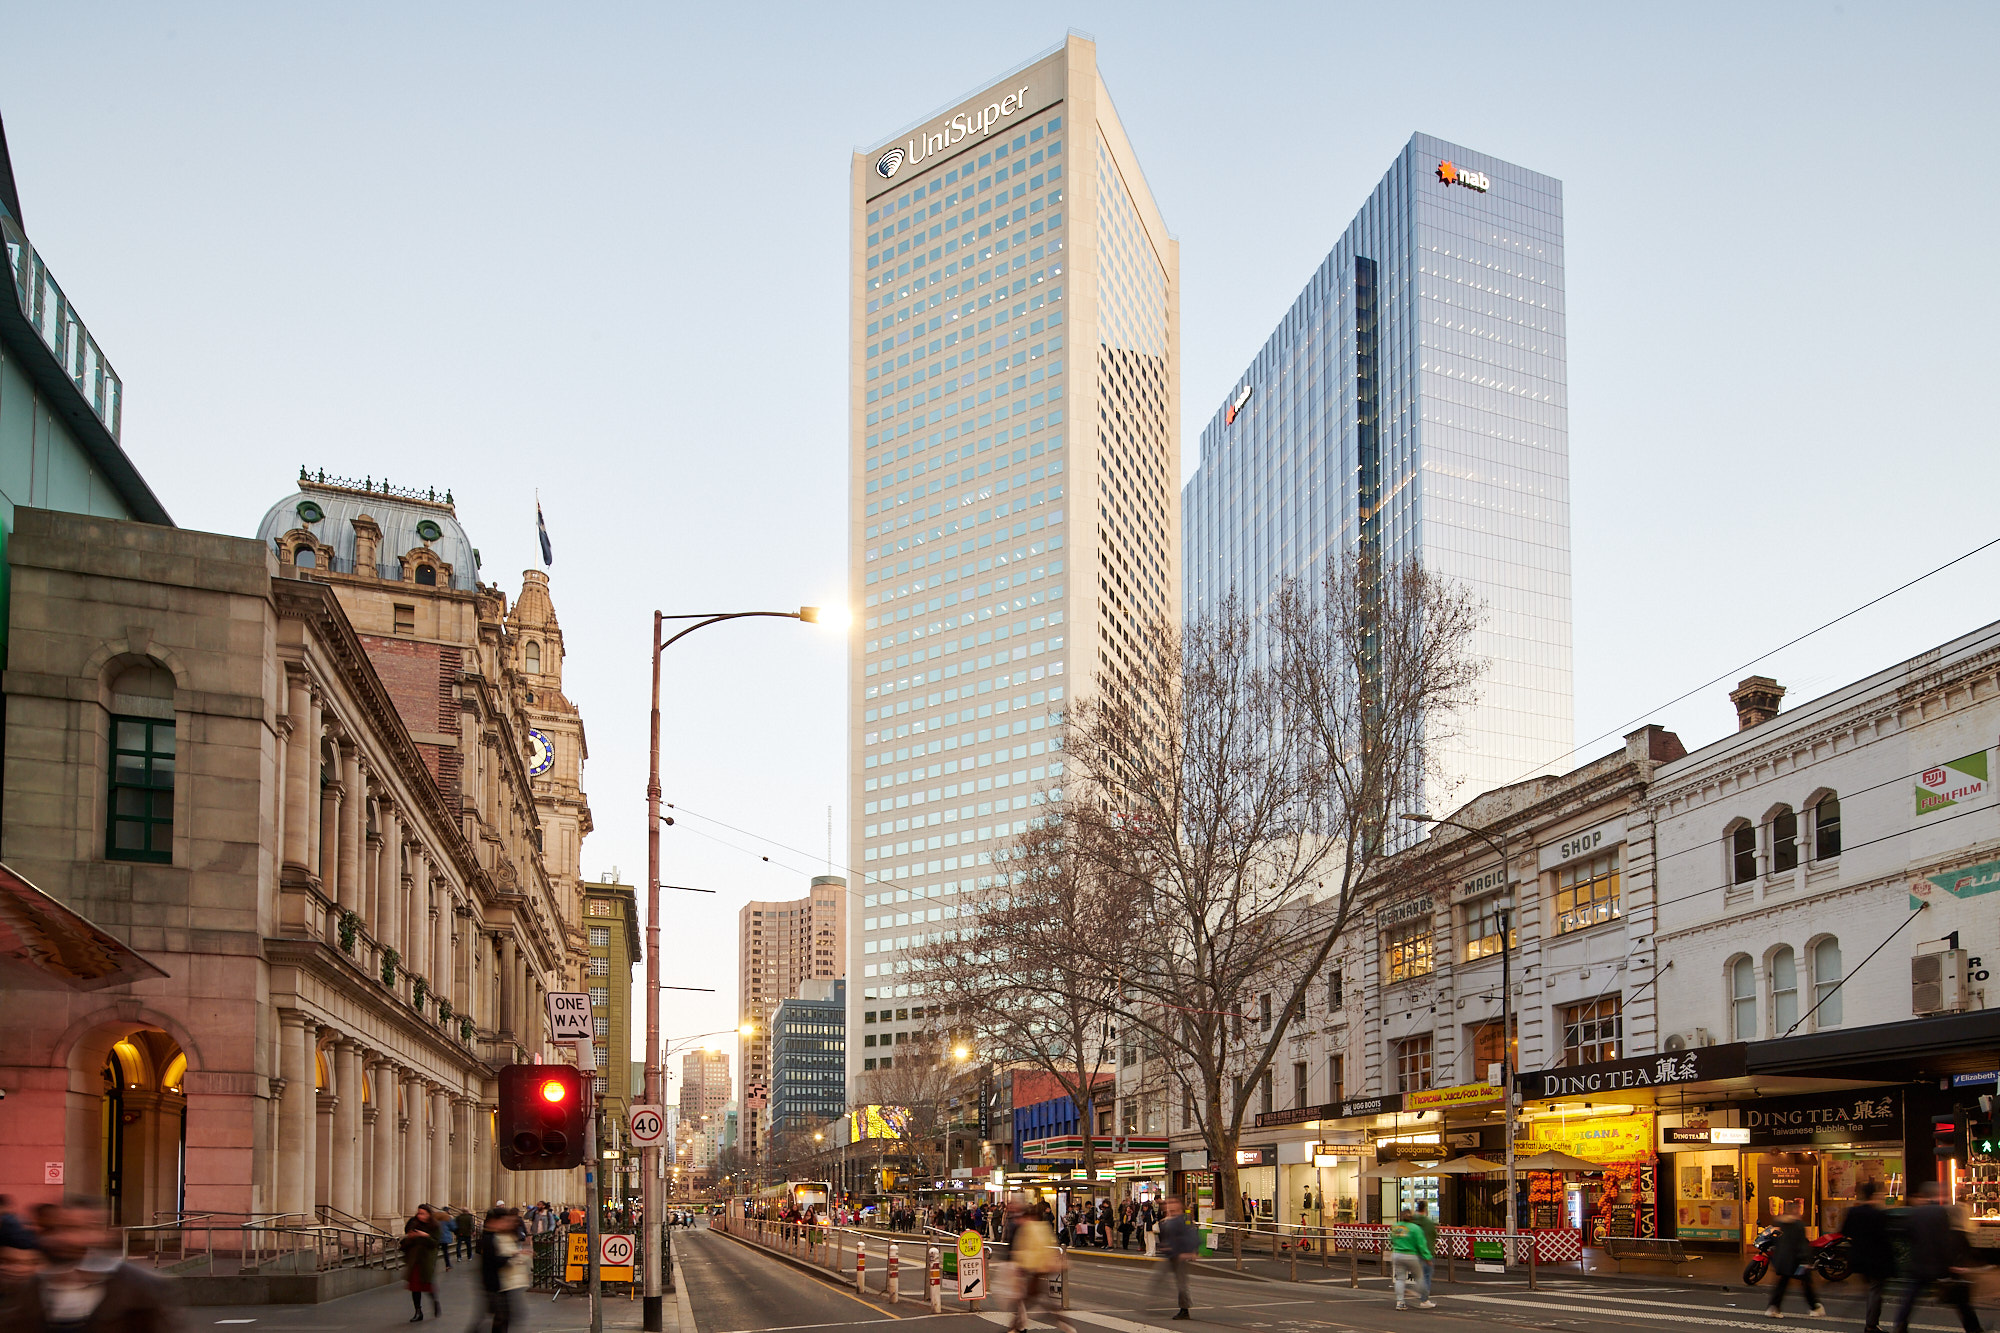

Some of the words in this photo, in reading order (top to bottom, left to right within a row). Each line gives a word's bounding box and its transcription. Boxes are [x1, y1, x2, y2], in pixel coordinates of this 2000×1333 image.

[908, 86, 1029, 165] UniSuper
[1459, 168, 1490, 190] nab
[1561, 830, 1602, 859] SHOP
[1464, 869, 1504, 896] MAGIC
[556, 997, 585, 1010] ONE
[554, 1014, 588, 1027] WAY
[1544, 1073, 1601, 1097] DING
[1605, 1068, 1652, 1089] TEA
[1960, 1072, 1996, 1082] Elizabeth
[1480, 1087, 1493, 1097] BAR
[1353, 1102, 1365, 1110] UGG
[1365, 1099, 1381, 1109] BOOTS
[1747, 1110, 1802, 1127] DING
[1806, 1107, 1850, 1123] TEA
[635, 1117, 659, 1133] 40
[1772, 1127, 1814, 1136] Taiwanese
[1815, 1124, 1845, 1134] Bubble
[1847, 1122, 1864, 1132] Tea
[1396, 1146, 1435, 1157] goodgames
[1024, 1164, 1053, 1172] SUBWAY
[577, 1236, 587, 1244] EN
[574, 1245, 589, 1253] ROA
[608, 1243, 628, 1257] 40
[573, 1254, 589, 1262] WOR
[963, 1261, 980, 1269] KEEP
